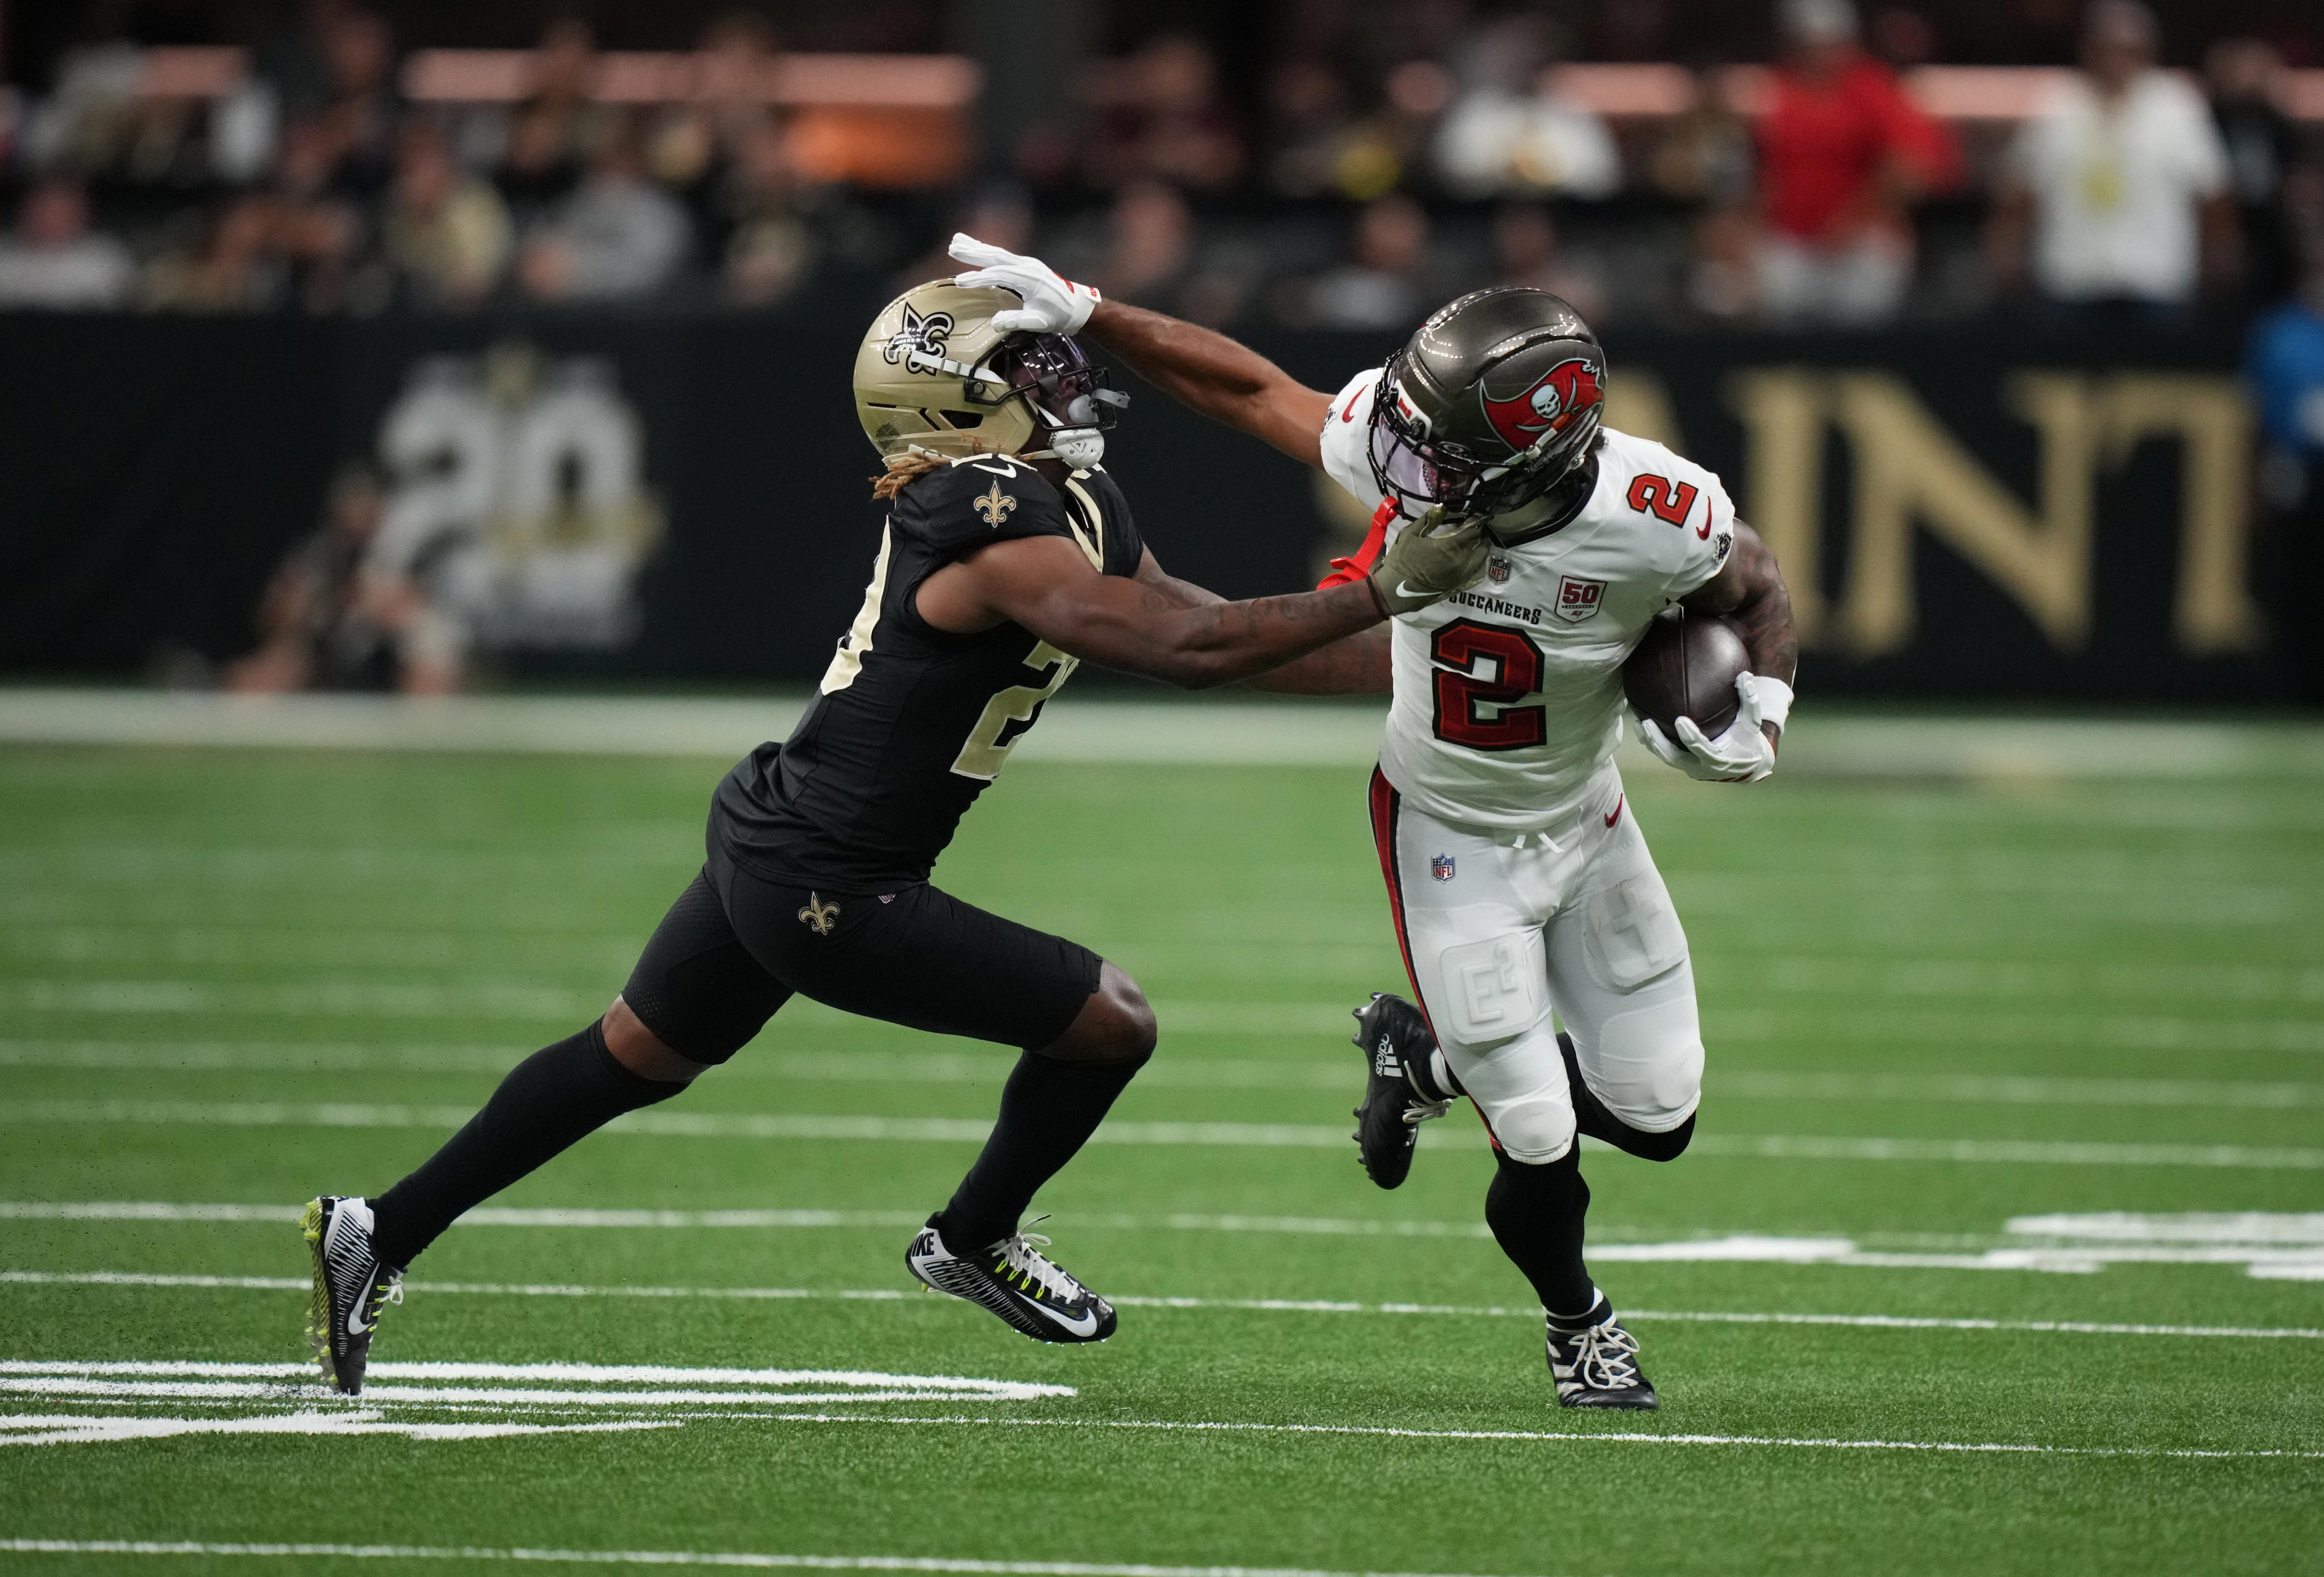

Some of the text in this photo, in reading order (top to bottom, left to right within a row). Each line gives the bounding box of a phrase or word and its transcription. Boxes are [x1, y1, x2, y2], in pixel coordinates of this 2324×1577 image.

[1626, 473, 1699, 529] 2
[1490, 566, 1506, 580] NFL
[1562, 582, 1600, 604] 50
[1431, 616, 1547, 752] 2
[1435, 866, 1452, 878] NFL
[1375, 1033, 1389, 1077] adidas
